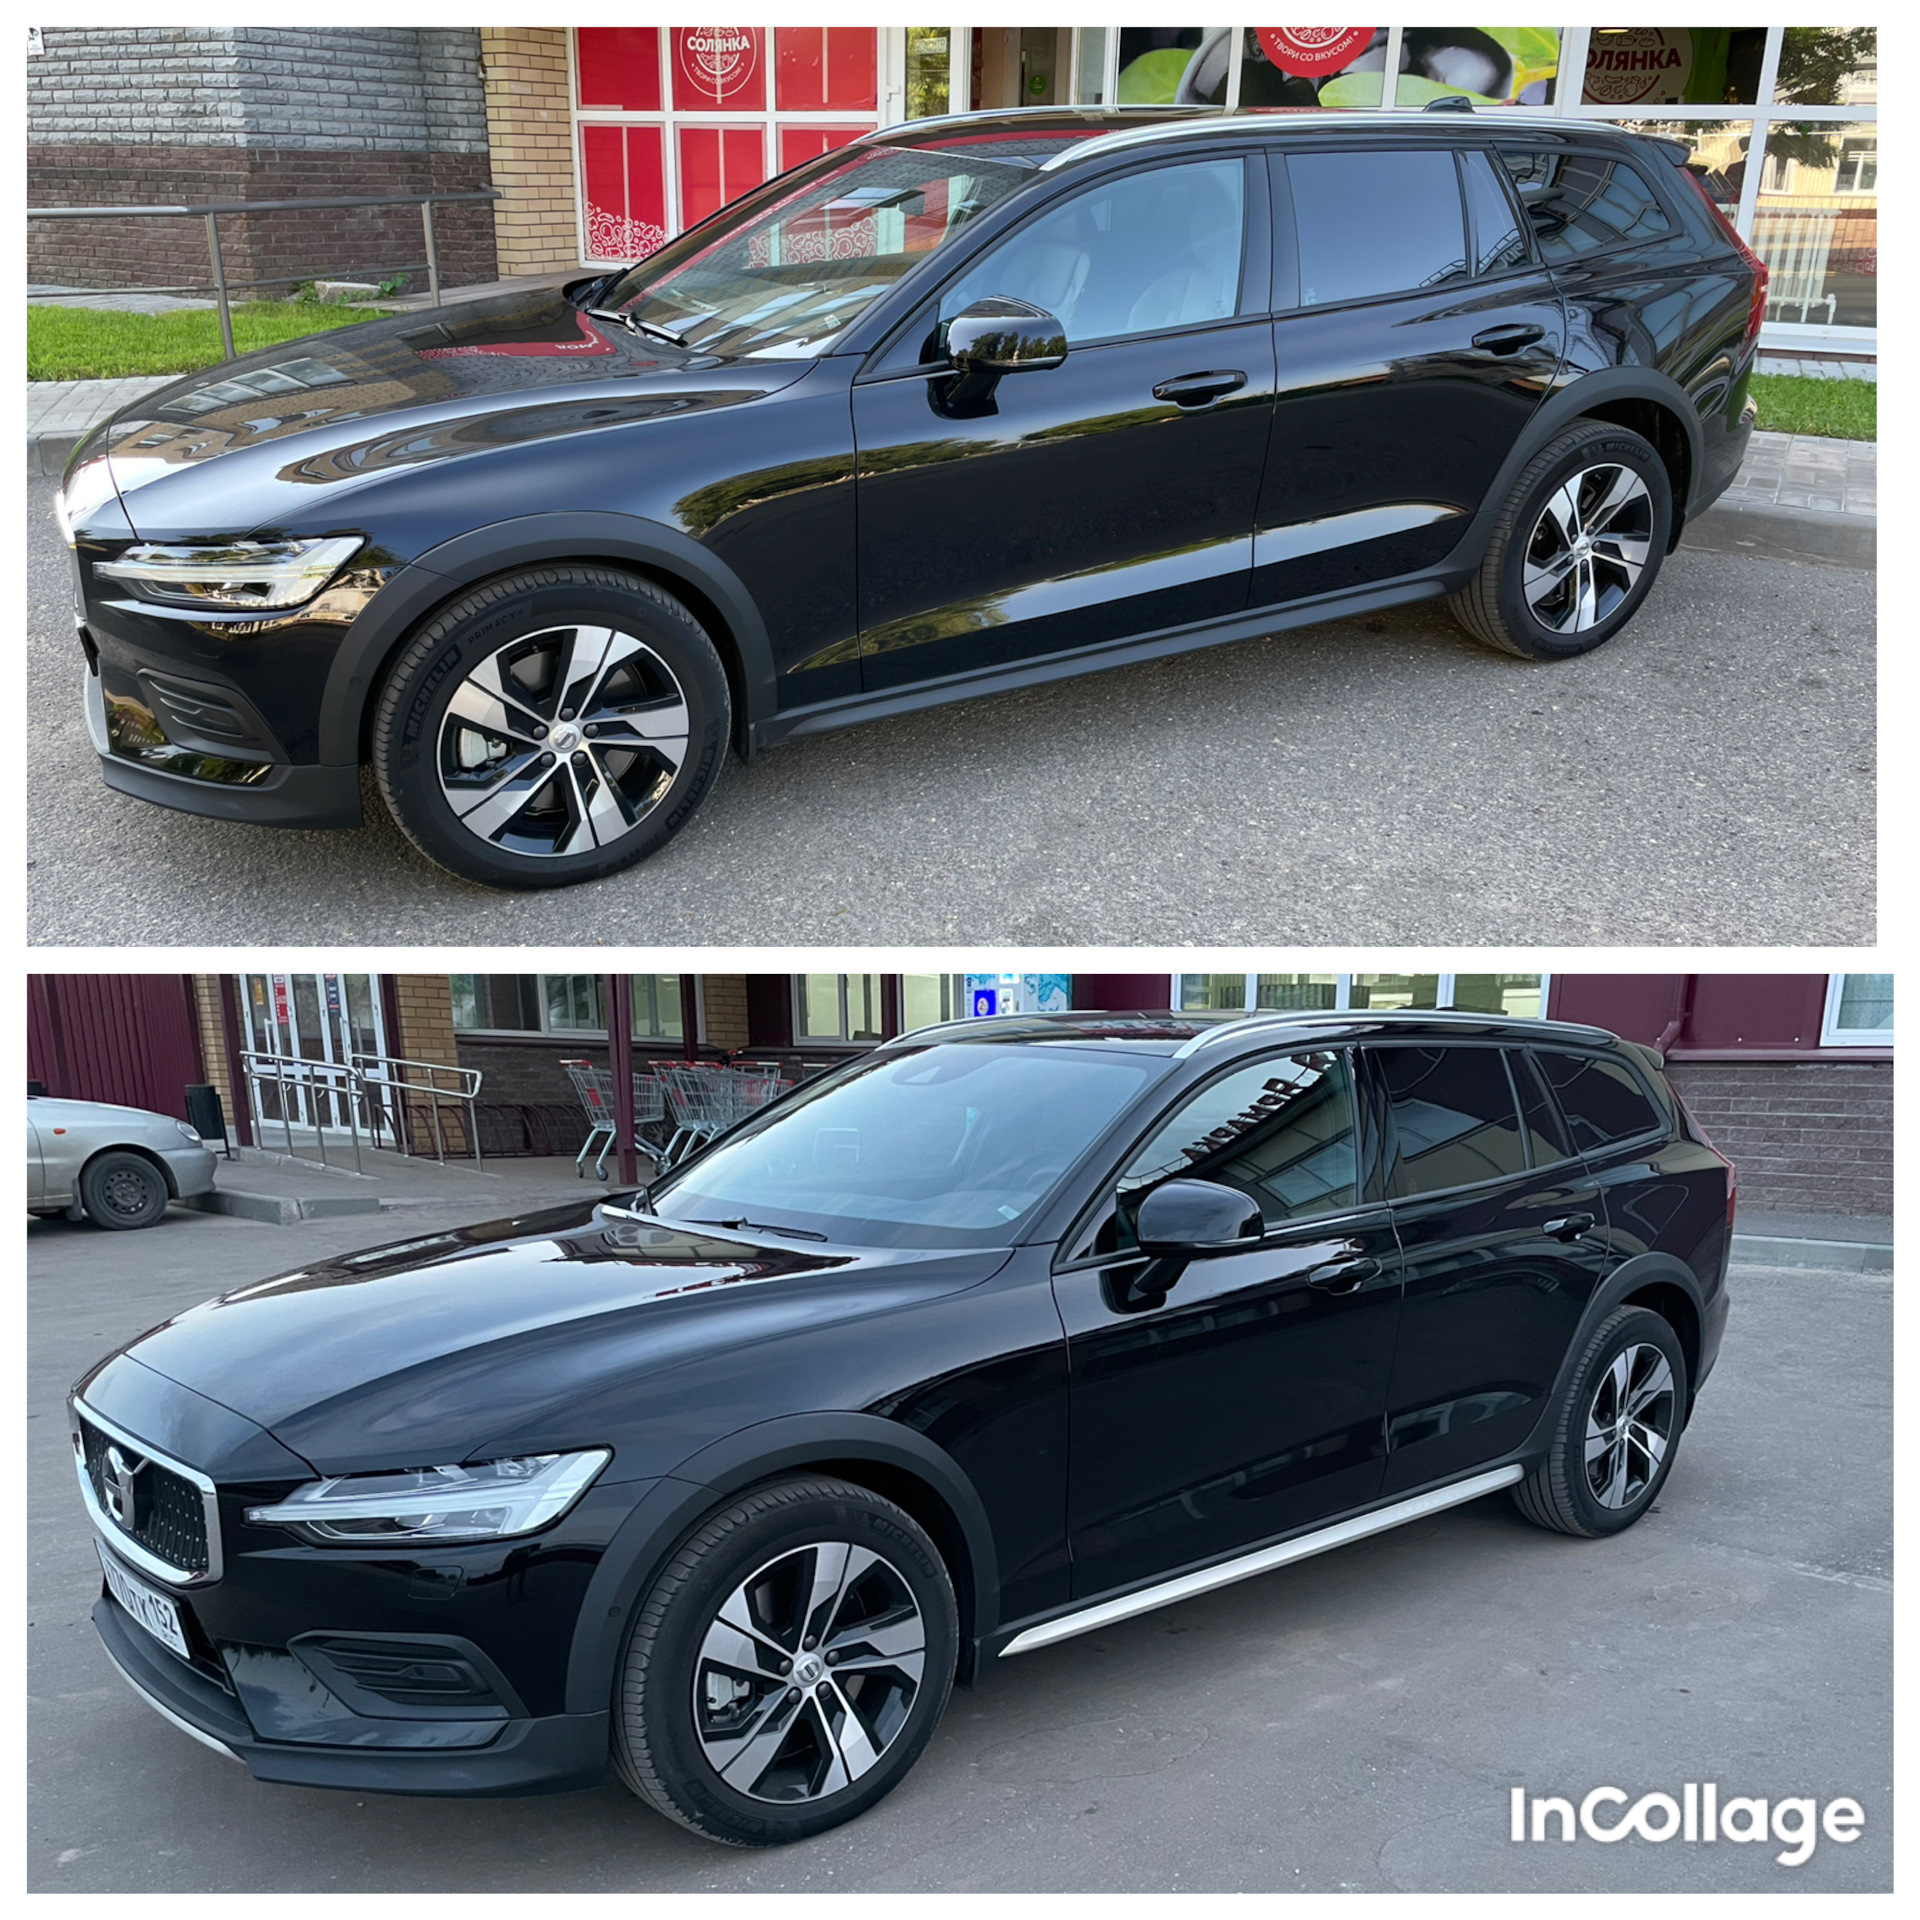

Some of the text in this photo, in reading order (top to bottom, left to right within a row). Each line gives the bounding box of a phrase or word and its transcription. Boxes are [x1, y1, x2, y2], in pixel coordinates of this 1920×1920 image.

[687, 35, 750, 52] СОЛЯНКА
[1273, 35, 1355, 62] ТВОРИ СО ВКУСОМ!
[1586, 47, 1682, 72] ОЛЯНКА
[468, 611, 516, 645] PRIMACY
[406, 646, 457, 739] MICHELIN
[667, 747, 714, 828] MICHELIN
[872, 1517, 936, 1576] MICHELIN
[149, 1594, 178, 1636] 152
